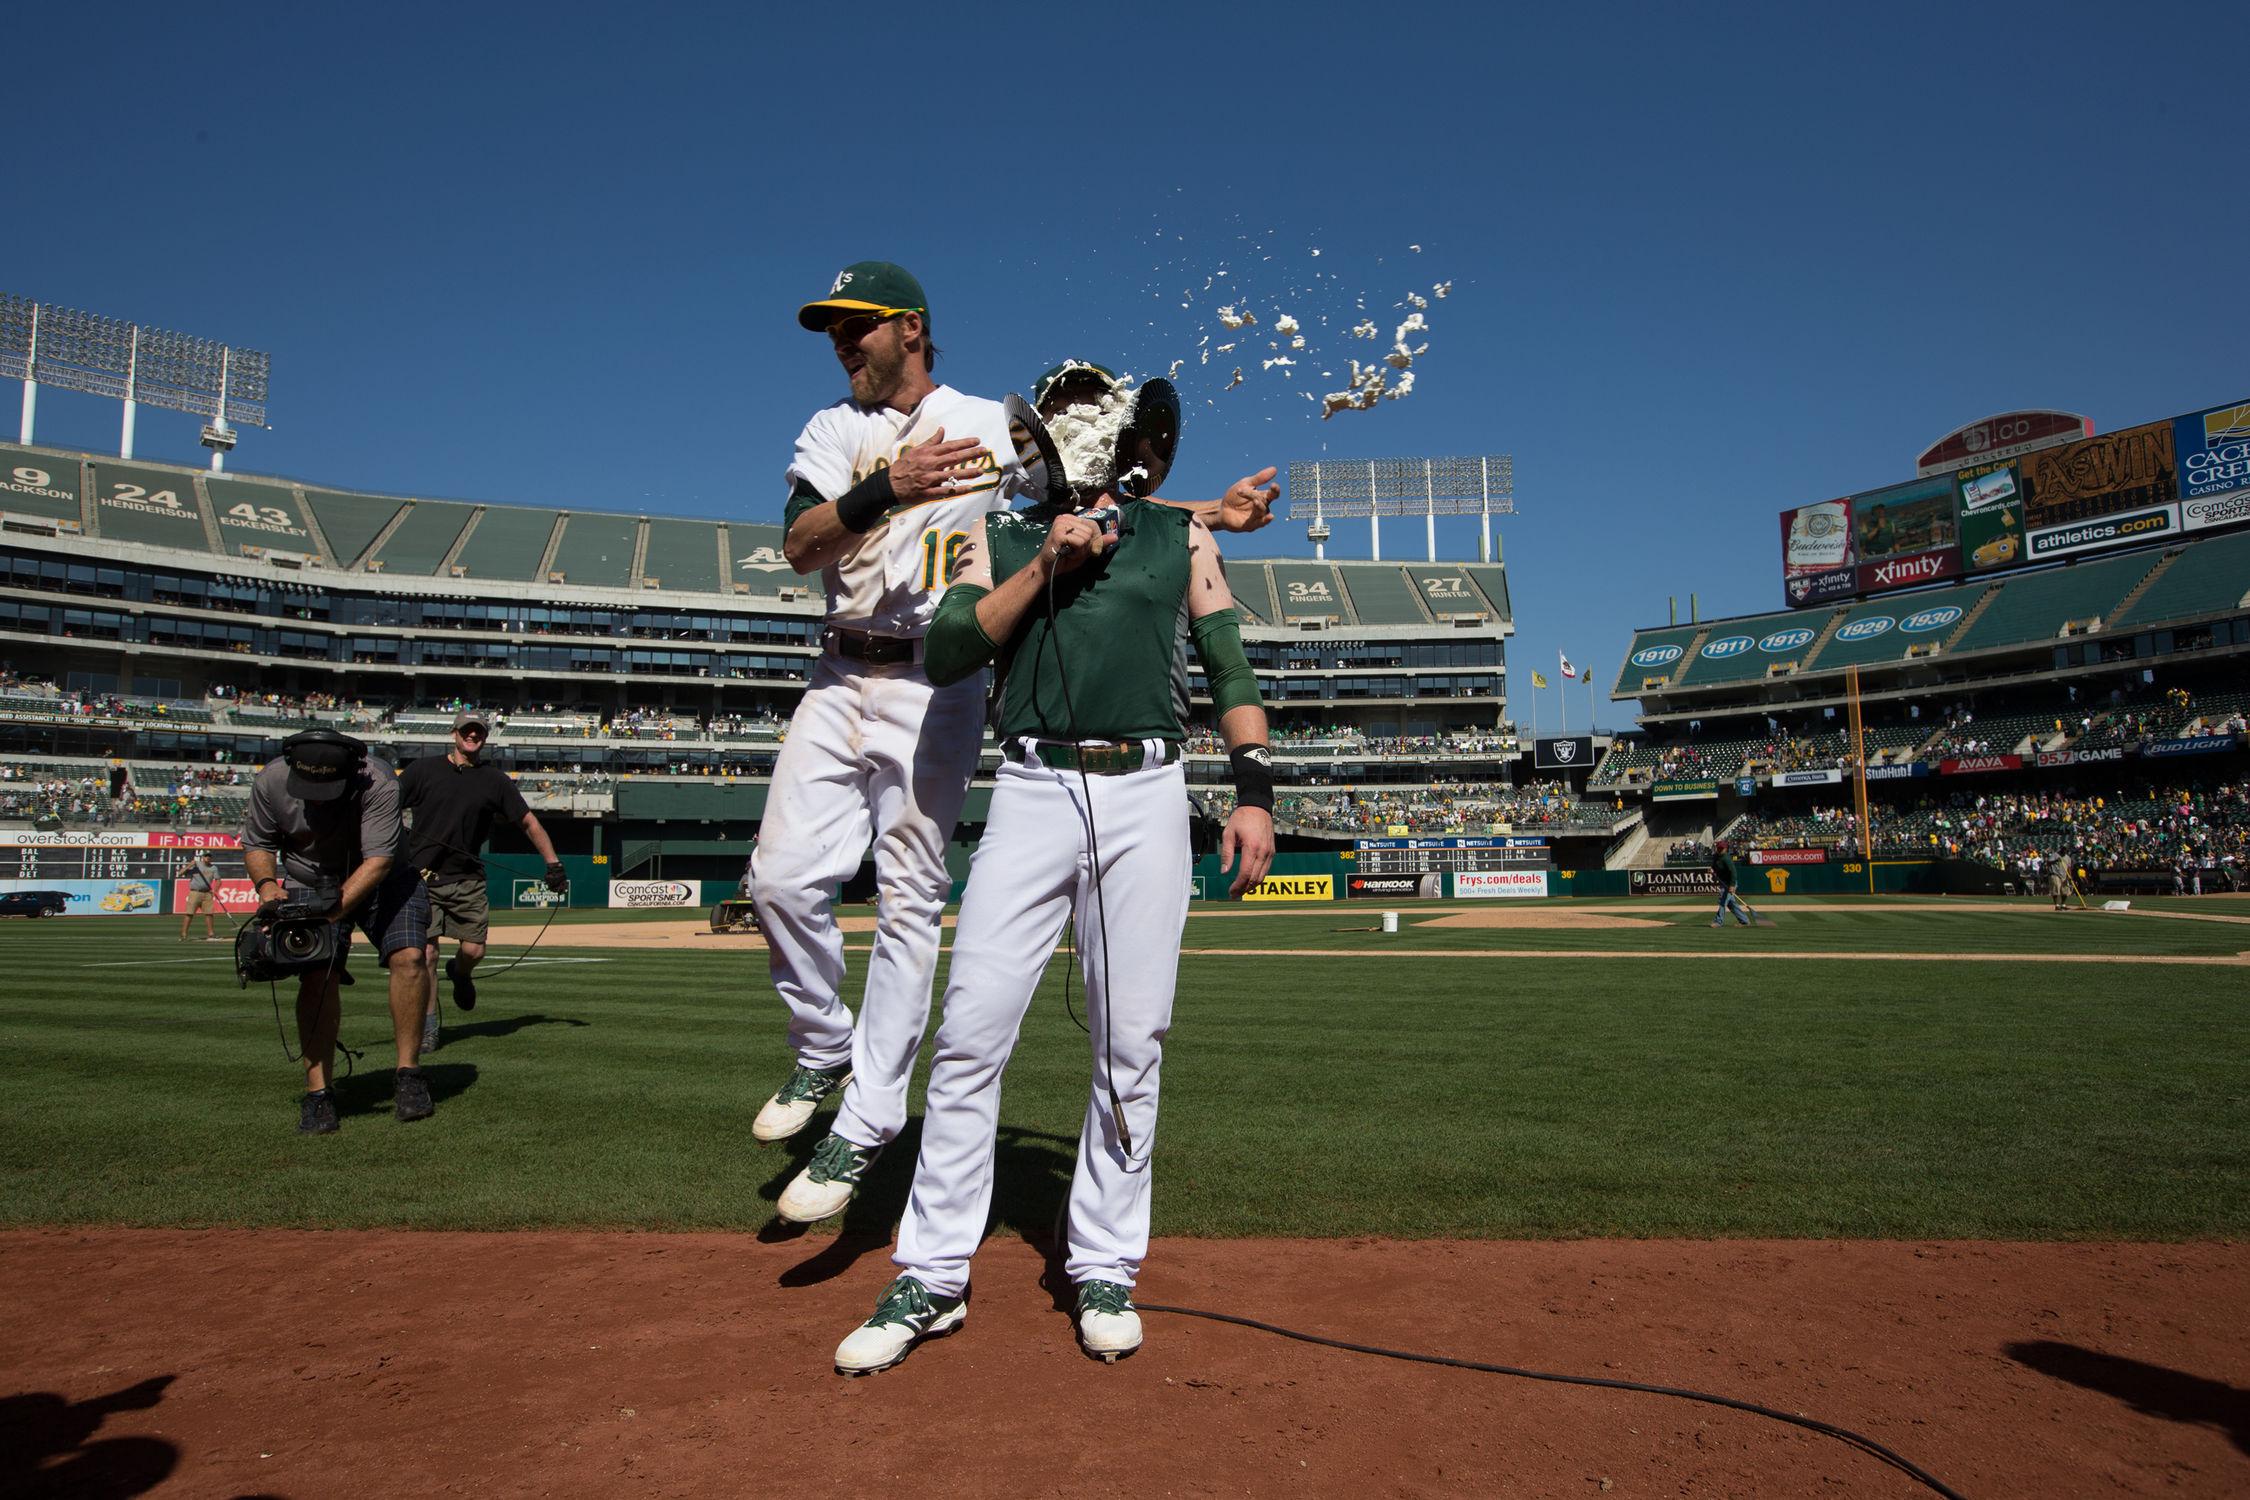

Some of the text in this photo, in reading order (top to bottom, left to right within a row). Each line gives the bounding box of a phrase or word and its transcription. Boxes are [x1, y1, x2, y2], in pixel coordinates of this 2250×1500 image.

[13, 467, 50, 487] 9
[1958, 468, 1974, 480] Get
[1976, 465, 1991, 476] the
[2189, 481, 2234, 496] CASINO
[113, 484, 182, 509] 24
[101, 498, 198, 520] HENDERSON
[229, 503, 292, 527] 43
[220, 516, 308, 537] ECKERSLEY
[2037, 515, 2165, 549] athletics.com
[1874, 556, 1944, 584] xfinity
[1423, 577, 1462, 592] 27
[1818, 573, 1850, 586] xfinity
[1287, 581, 1330, 596] 34
[1429, 590, 1471, 599] HUNTER
[1908, 611, 1953, 629] 1930
[1843, 620, 1888, 637] 1929
[1766, 631, 1810, 648] 1913
[1707, 639, 1748, 655] 1911
[1638, 647, 1679, 663] 1910
[2151, 739, 2231, 753] BUD LIGHT
[1958, 756, 2004, 770] AVAYA
[2039, 752, 2072, 765] 95.7
[2079, 748, 2122, 761] GAME
[1865, 764, 1912, 780] StubHub!
[1654, 784, 1674, 792] DOWN
[1684, 782, 1716, 790] BUSINESS
[17, 834, 134, 845] overstock.com
[160, 836, 173, 847] IF
[178, 836, 204, 847] IT'S
[593, 856, 607, 864] 388
[1340, 851, 1355, 859] 362
[1763, 853, 1823, 862] overstock.com
[1561, 870, 1576, 879] 367
[1843, 863, 1862, 873] 330
[1460, 874, 1542, 886] Frys.com/deals
[1647, 872, 1719, 884] LOANMAR
[619, 884, 668, 895] comcast
[1247, 881, 1328, 895] STANLEY
[1668, 885, 1692, 893] TITLE
[1693, 885, 1720, 893] LOANS
[628, 894, 682, 902] SPORTSNET
